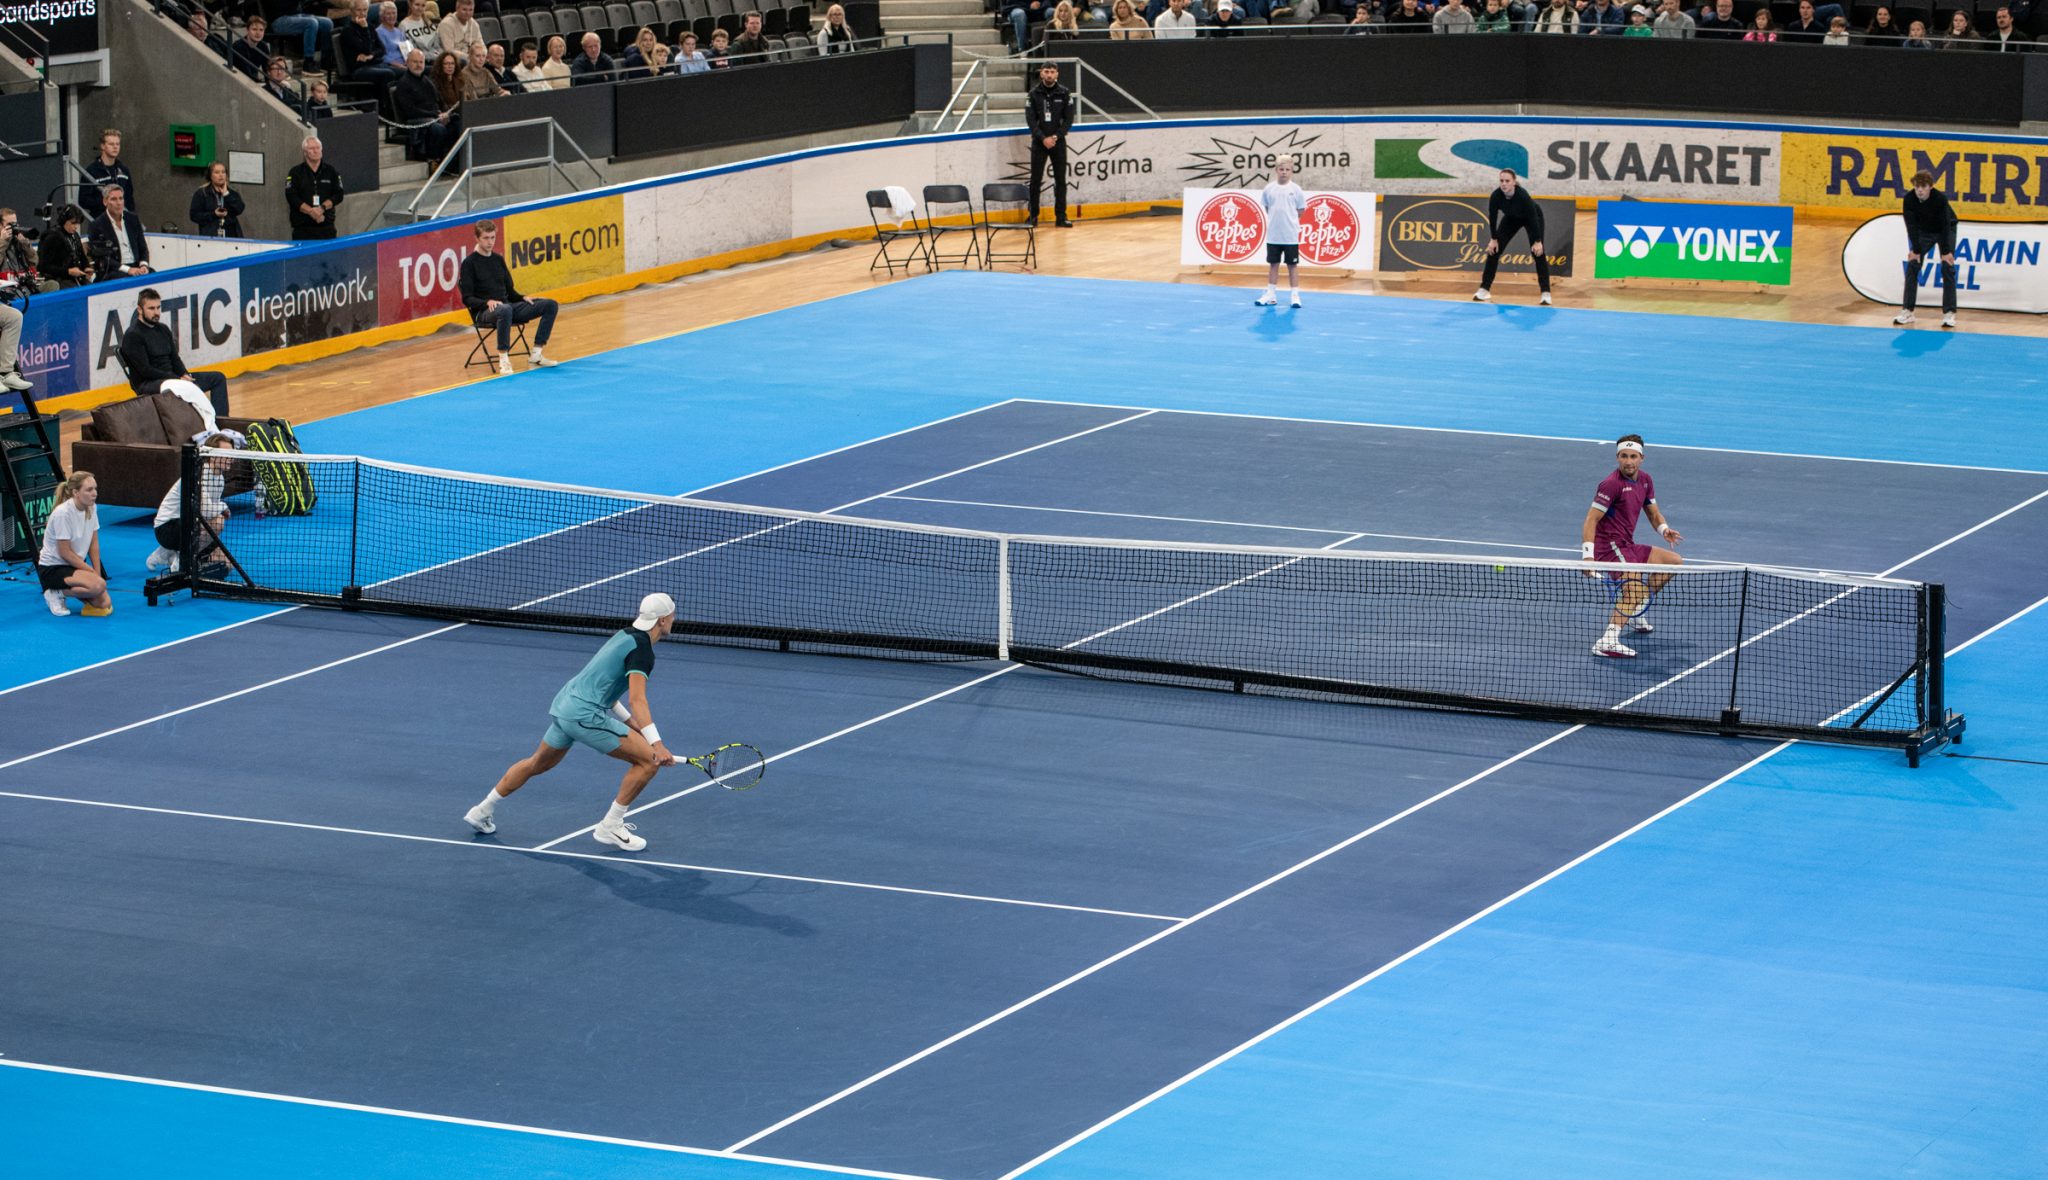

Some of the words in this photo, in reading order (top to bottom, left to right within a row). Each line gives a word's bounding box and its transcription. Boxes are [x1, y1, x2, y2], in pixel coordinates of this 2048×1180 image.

[1232, 151, 1350, 174] enegima
[1547, 139, 1771, 187] SKAARET
[1202, 221, 1258, 243] Peppes
[1299, 222, 1351, 245] Peppes
[1398, 220, 1485, 243] BISLET
[1456, 243, 1567, 266] Liousne
[1672, 226, 1780, 264] YONEX
[245, 268, 374, 325] dreamwork.
[97, 287, 233, 371] ATIC
[16, 341, 70, 368] klame
